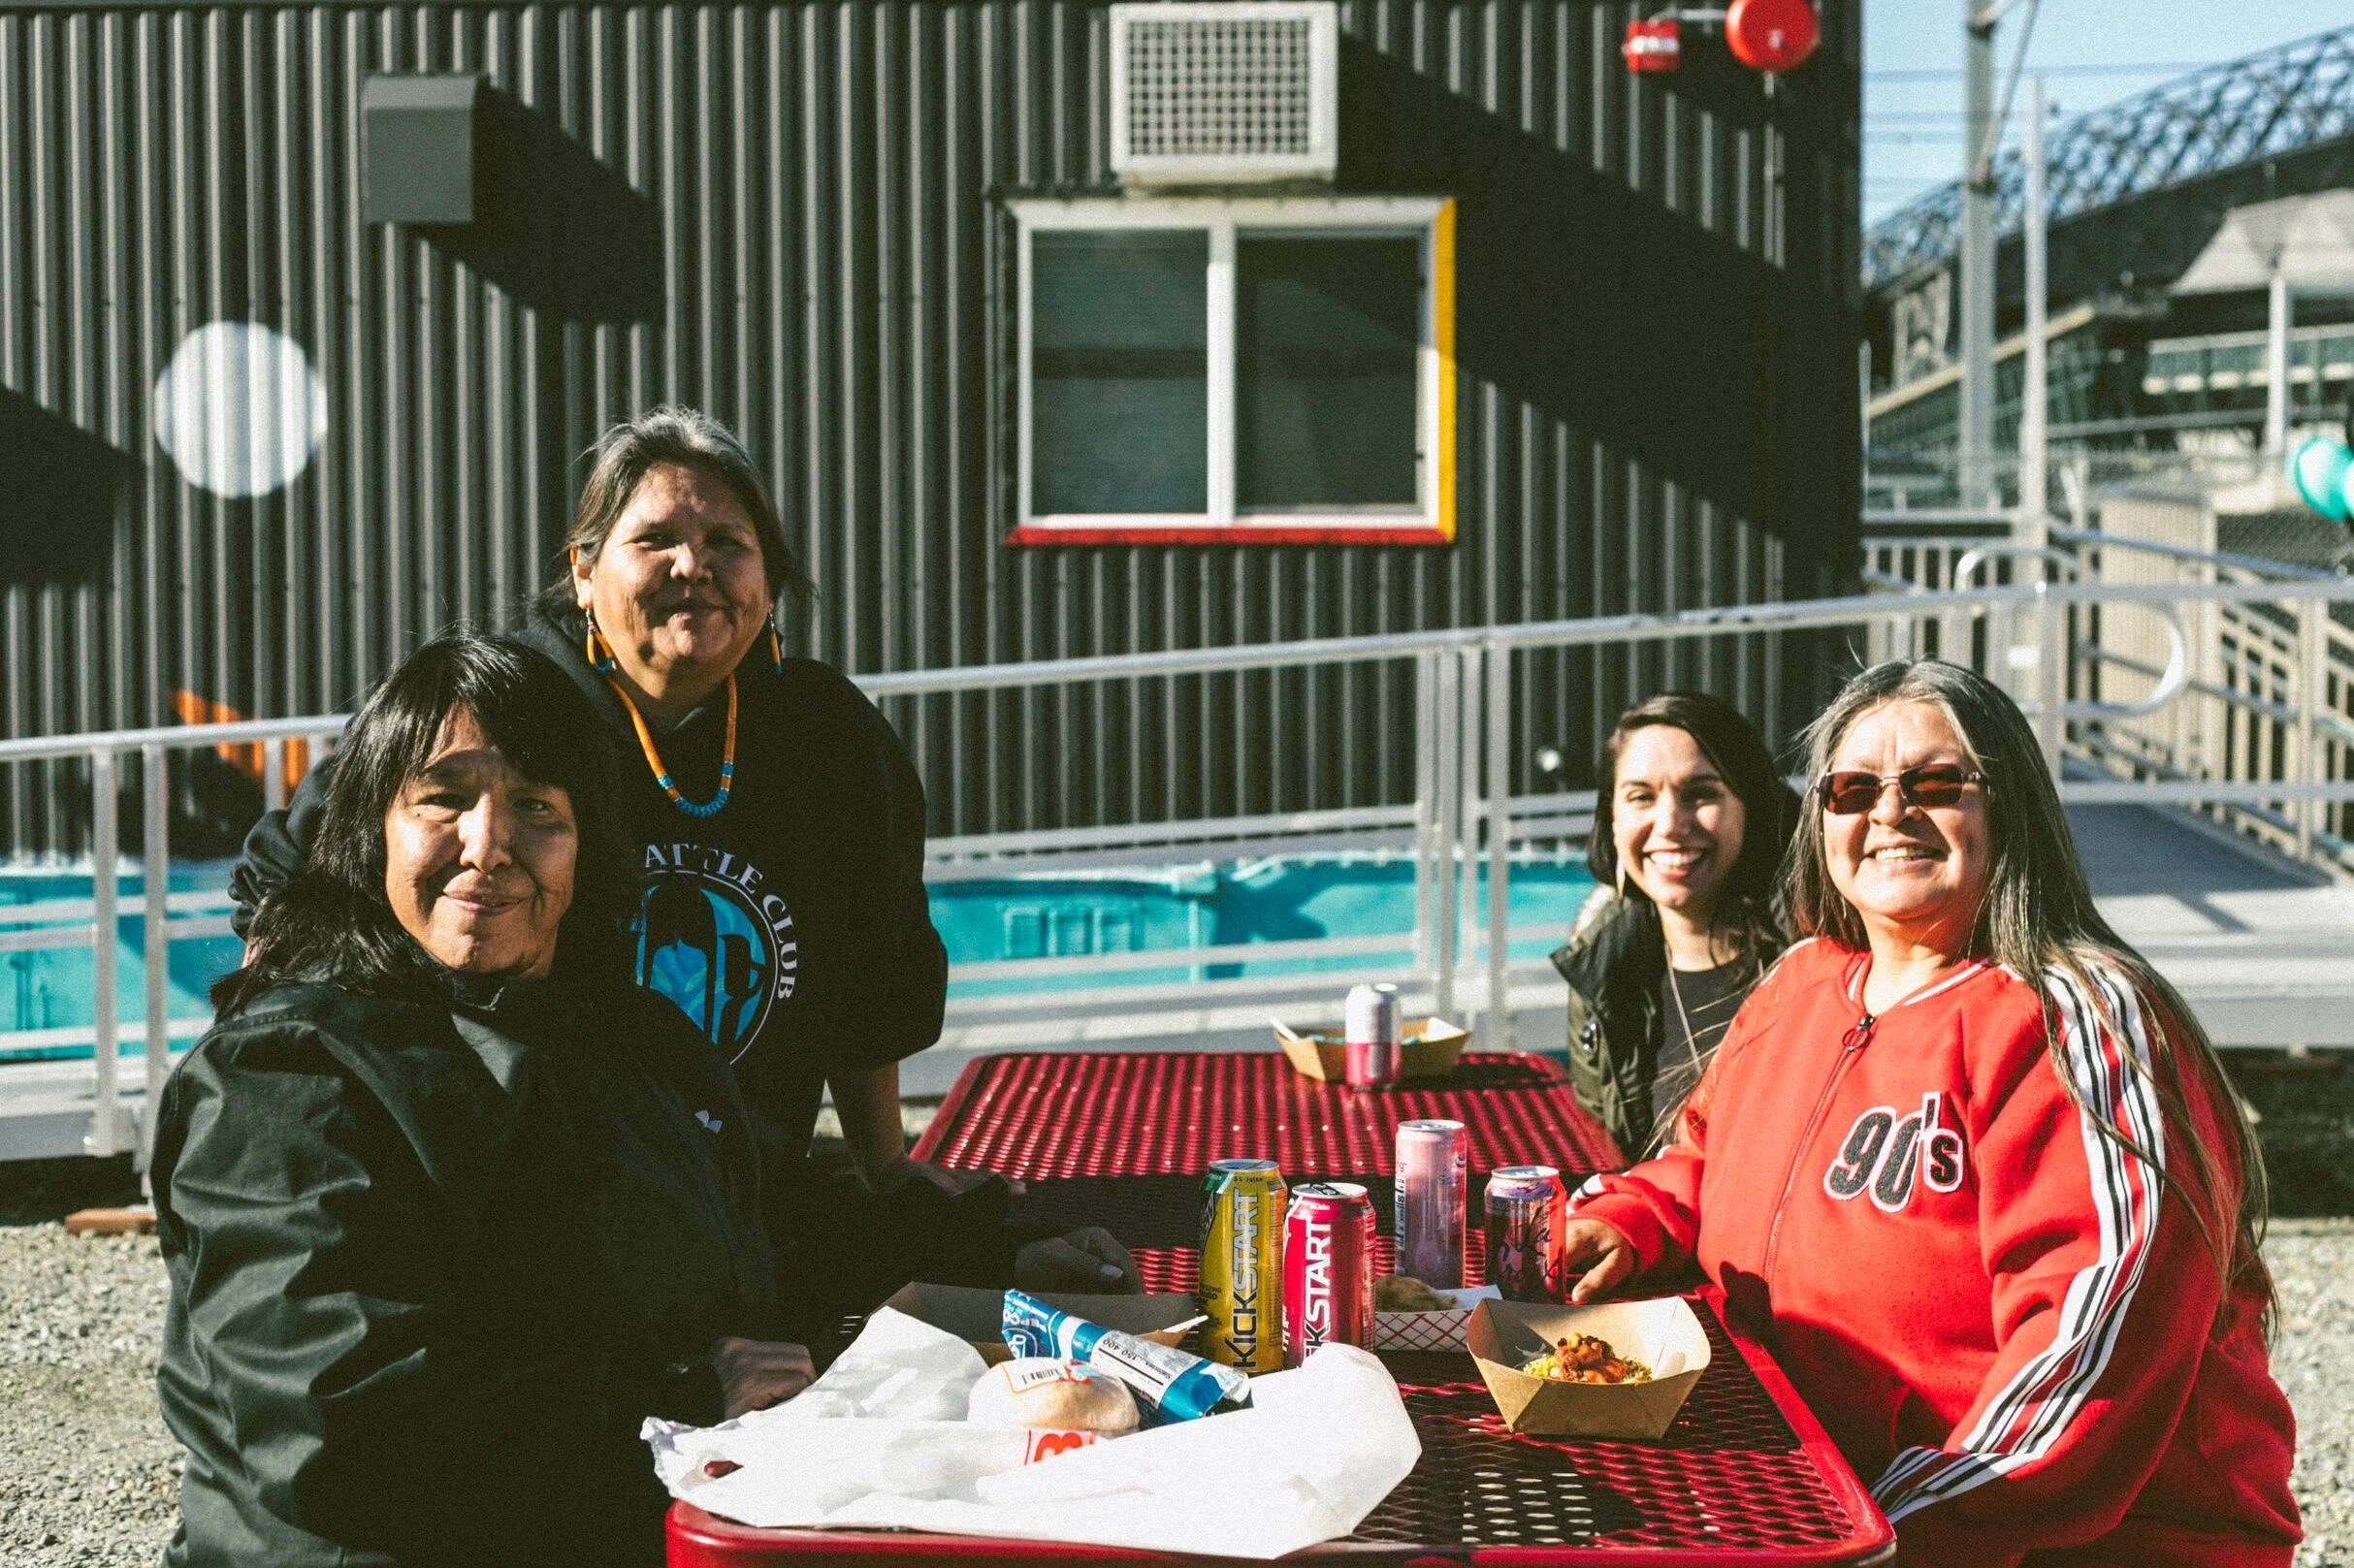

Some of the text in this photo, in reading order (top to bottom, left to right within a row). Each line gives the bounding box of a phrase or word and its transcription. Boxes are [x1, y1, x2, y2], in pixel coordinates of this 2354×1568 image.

[762, 894, 798, 1000] CLUB
[1823, 1091, 1963, 1213] 90's
[1224, 1187, 1259, 1369] KICKSTART
[1102, 1338, 1120, 1351] 400
[1121, 1350, 1137, 1360] 150
